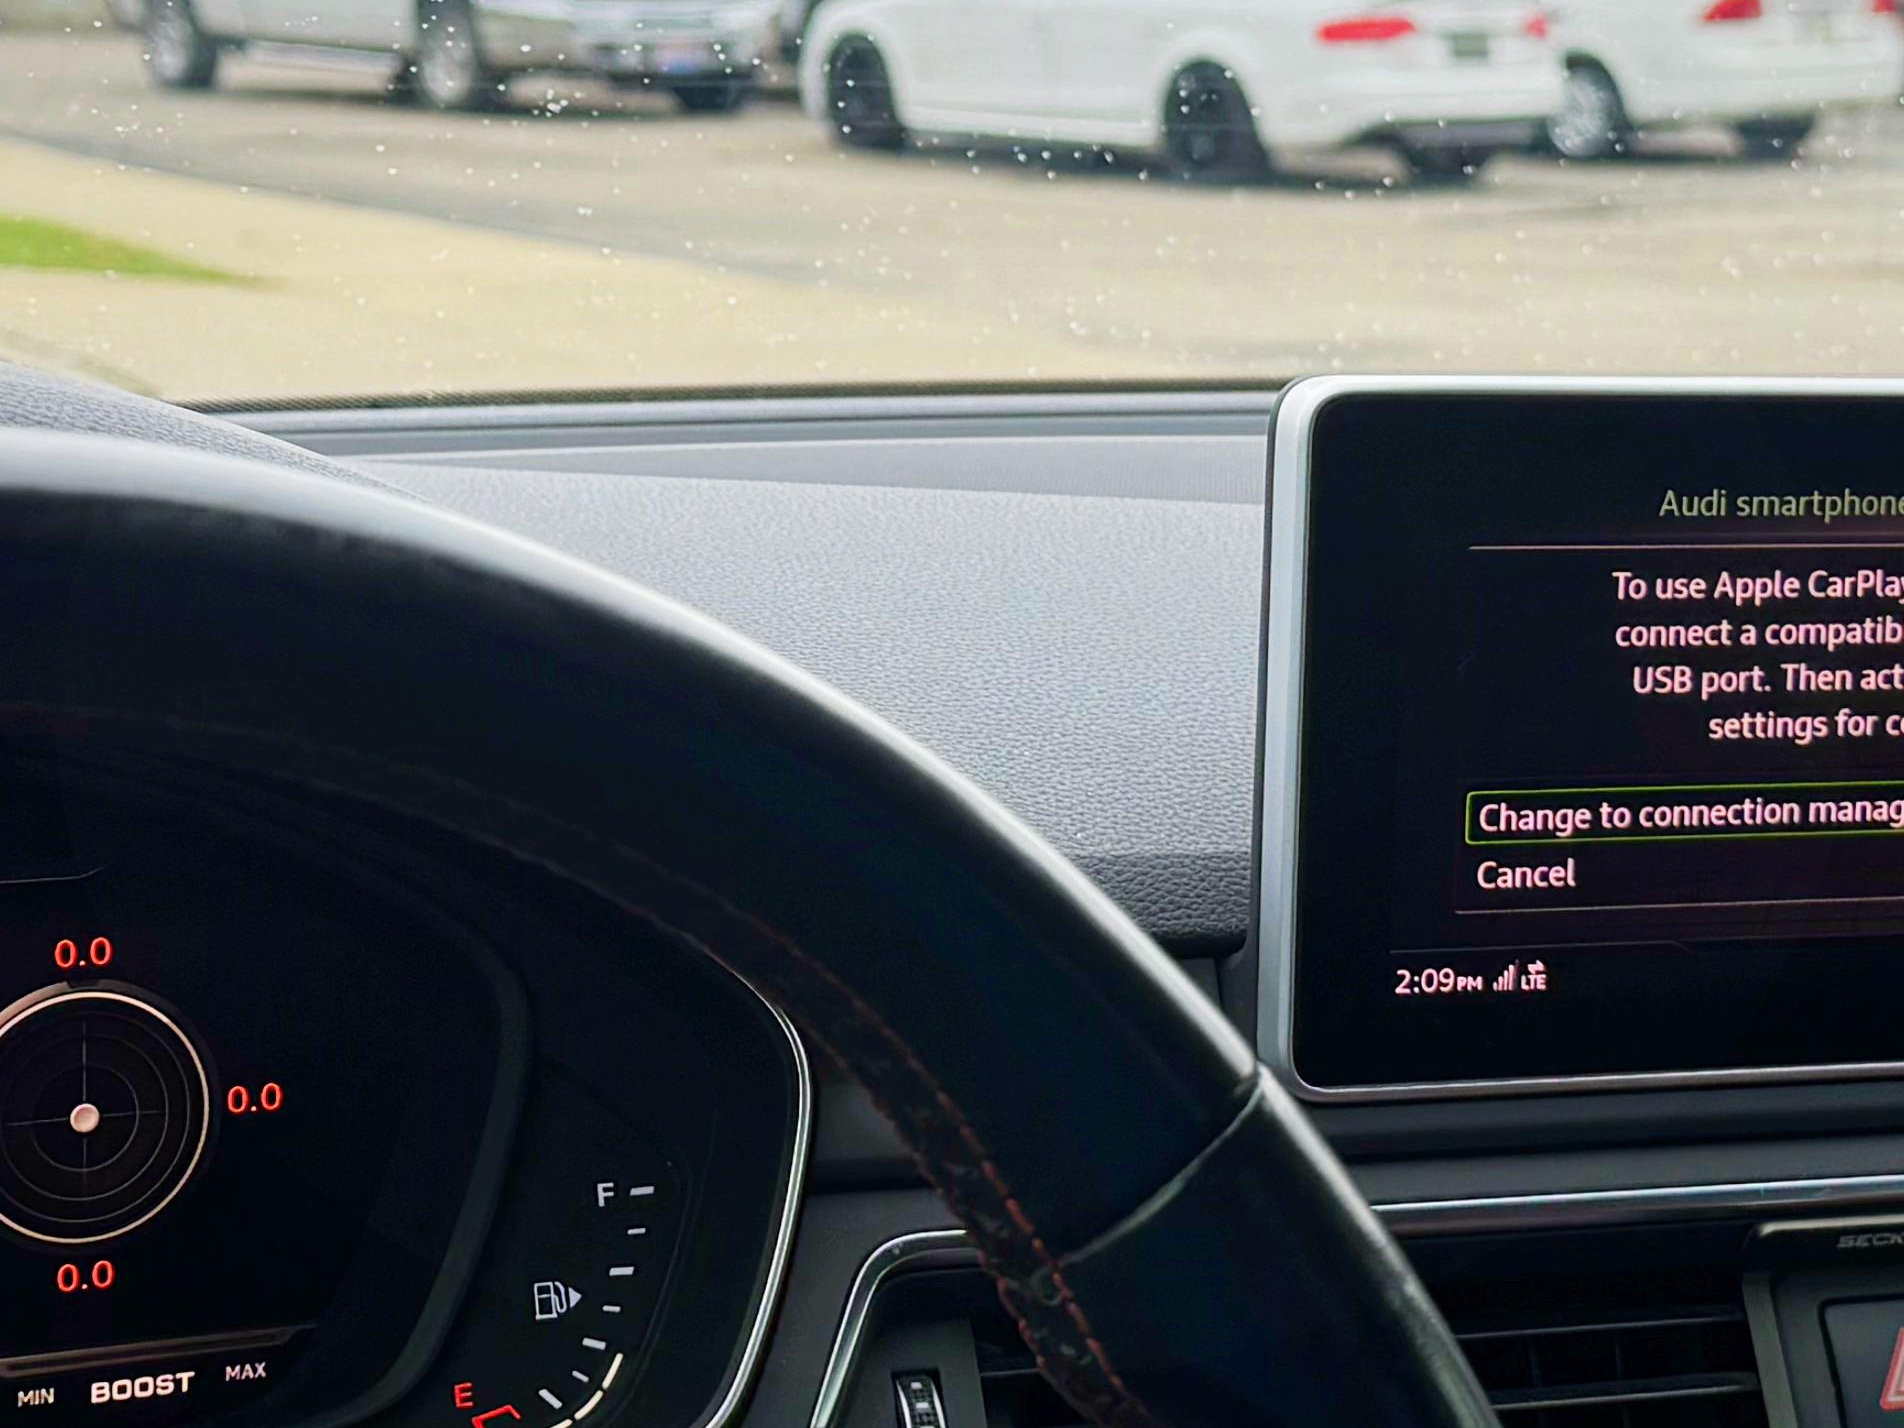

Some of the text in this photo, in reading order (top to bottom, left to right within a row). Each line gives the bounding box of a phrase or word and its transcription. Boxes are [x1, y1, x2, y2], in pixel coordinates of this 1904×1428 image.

[1659, 488, 1727, 517] Audi
[1611, 571, 1648, 601] To
[1655, 577, 1707, 600] use
[1713, 569, 1801, 607] Apple
[1615, 619, 1733, 647] connect
[1739, 624, 1757, 646] a
[1633, 665, 1693, 694] USB
[1701, 665, 1771, 701] port.
[1780, 662, 1853, 692] Then
[1708, 710, 1829, 746] settings
[1834, 707, 1879, 737] for
[1479, 802, 1592, 838] Change
[1599, 802, 1632, 829] to
[1638, 796, 1801, 828] connection
[1477, 858, 1576, 889] Cancel
[54, 936, 113, 969] 0.0
[1520, 972, 1547, 991] LTE
[227, 1082, 283, 1114] 0.0
[596, 1182, 615, 1207] F
[56, 1259, 115, 1293] 0.0
[17, 1361, 267, 1408] MIN BOOST MAX
[453, 1382, 474, 1408] E
